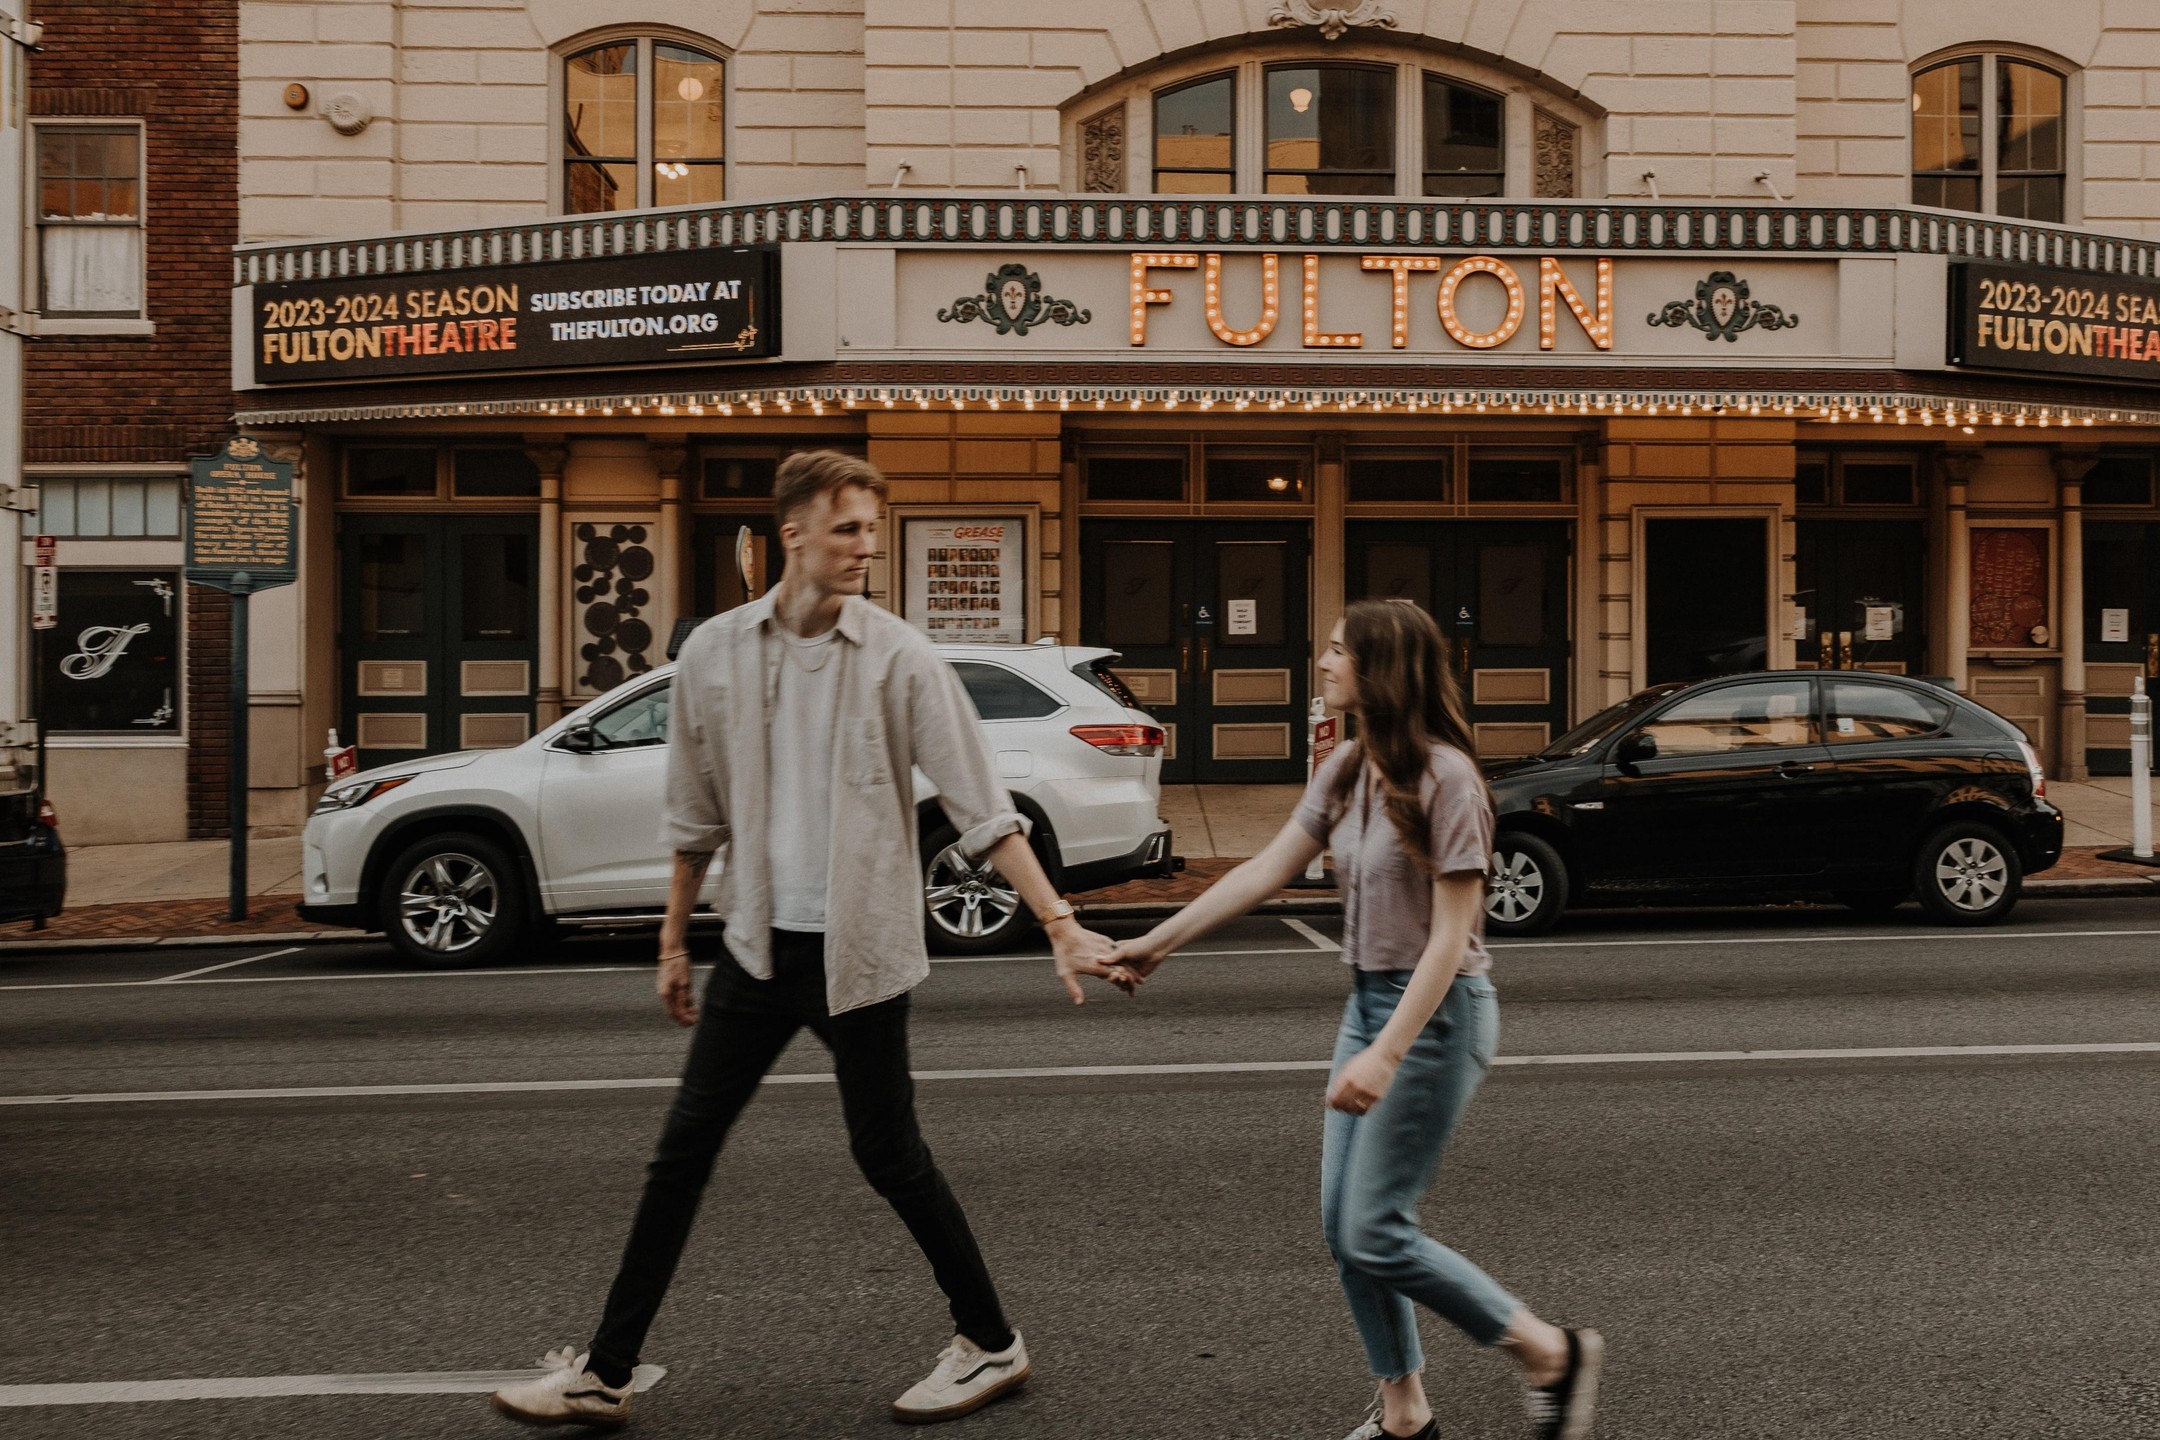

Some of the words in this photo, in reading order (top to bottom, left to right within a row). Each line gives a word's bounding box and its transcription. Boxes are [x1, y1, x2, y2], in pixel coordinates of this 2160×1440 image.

[263, 292, 399, 329] 2023-2024
[405, 283, 519, 319] SEASON
[530, 286, 637, 313] SUBSCRIBE
[639, 282, 712, 305] TODAY
[712, 279, 742, 301] AT
[1130, 253, 1613, 349] FULTON
[1978, 278, 2110, 321] 2023-2024
[2115, 292, 2160, 326] SEA
[549, 312, 719, 342] THEFULTON.ORG
[954, 526, 1006, 539] GREASE
